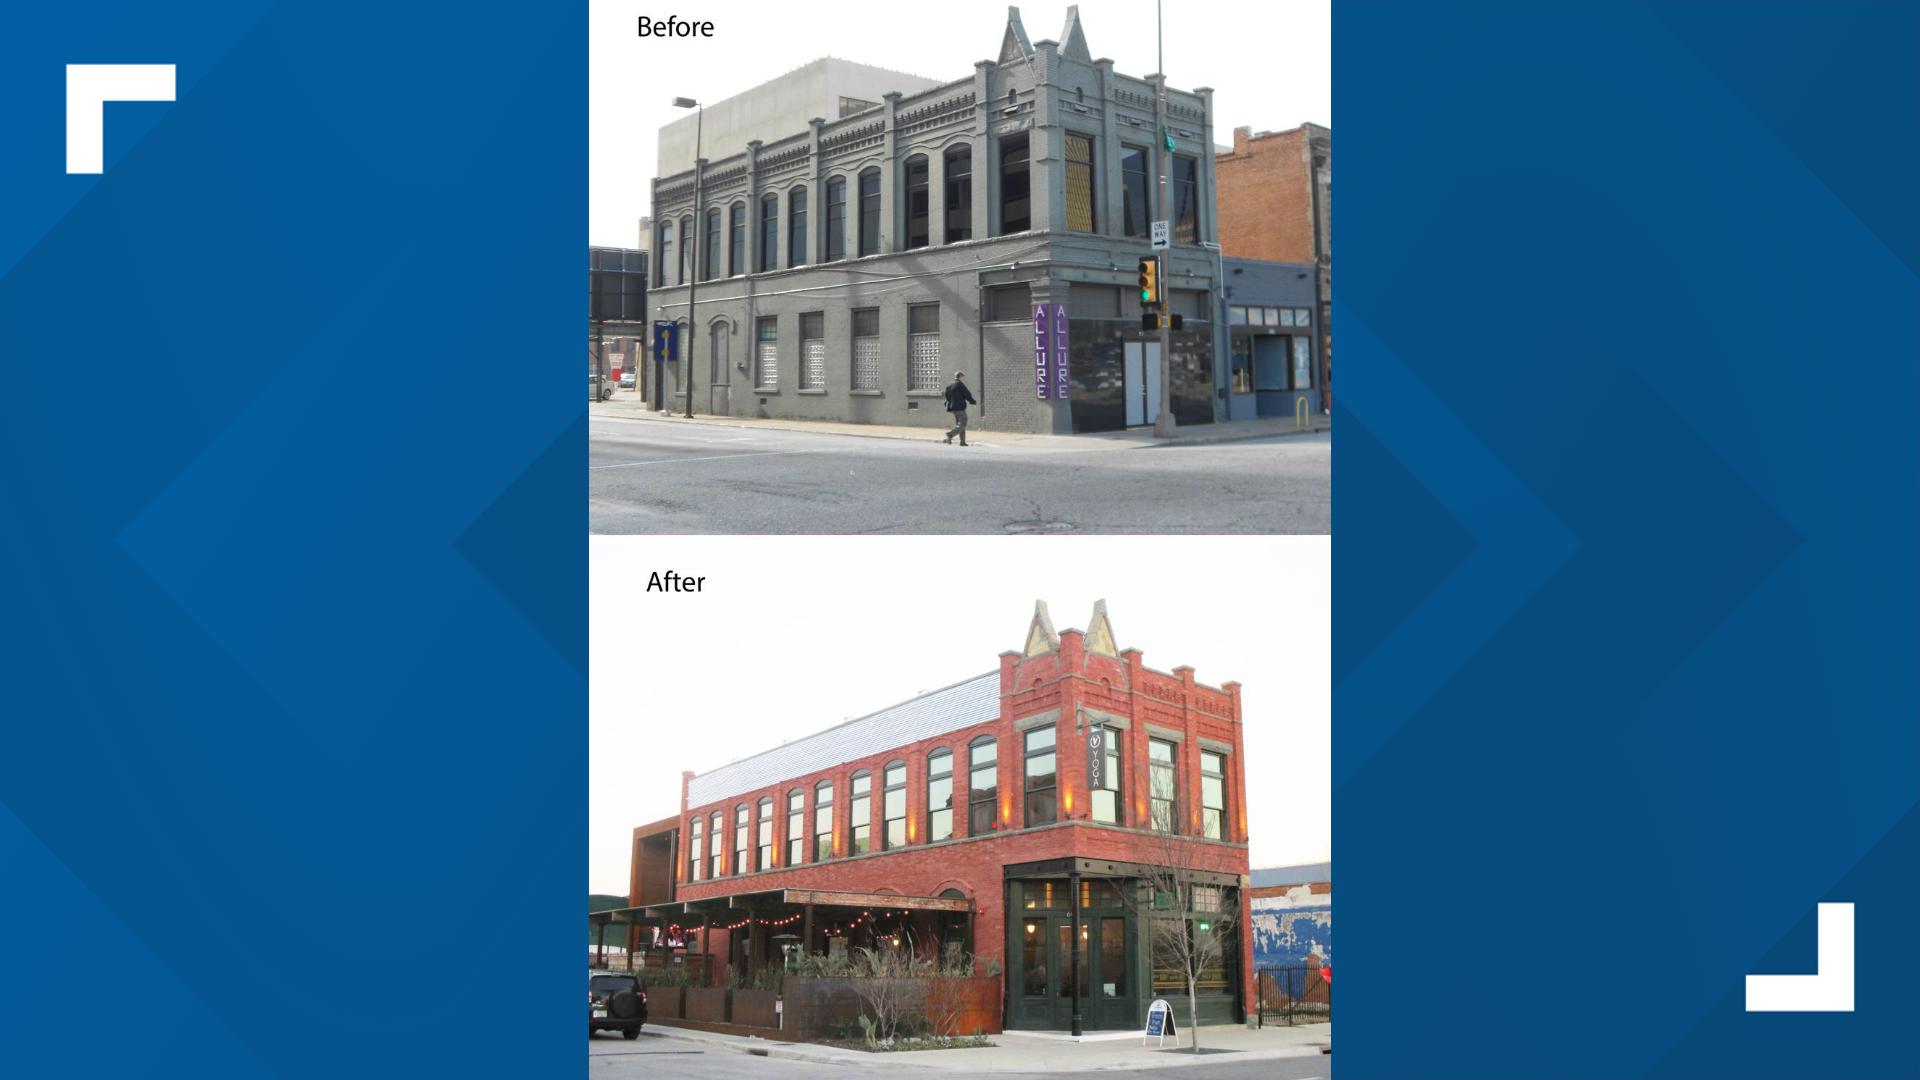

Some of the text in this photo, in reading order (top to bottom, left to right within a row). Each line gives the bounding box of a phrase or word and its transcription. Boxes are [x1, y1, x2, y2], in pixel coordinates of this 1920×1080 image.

[1153, 223, 1167, 231] ONE
[1154, 231, 1167, 239] WAY
[1035, 304, 1046, 399] ALLURE
[1057, 304, 1067, 399] ALLURE
